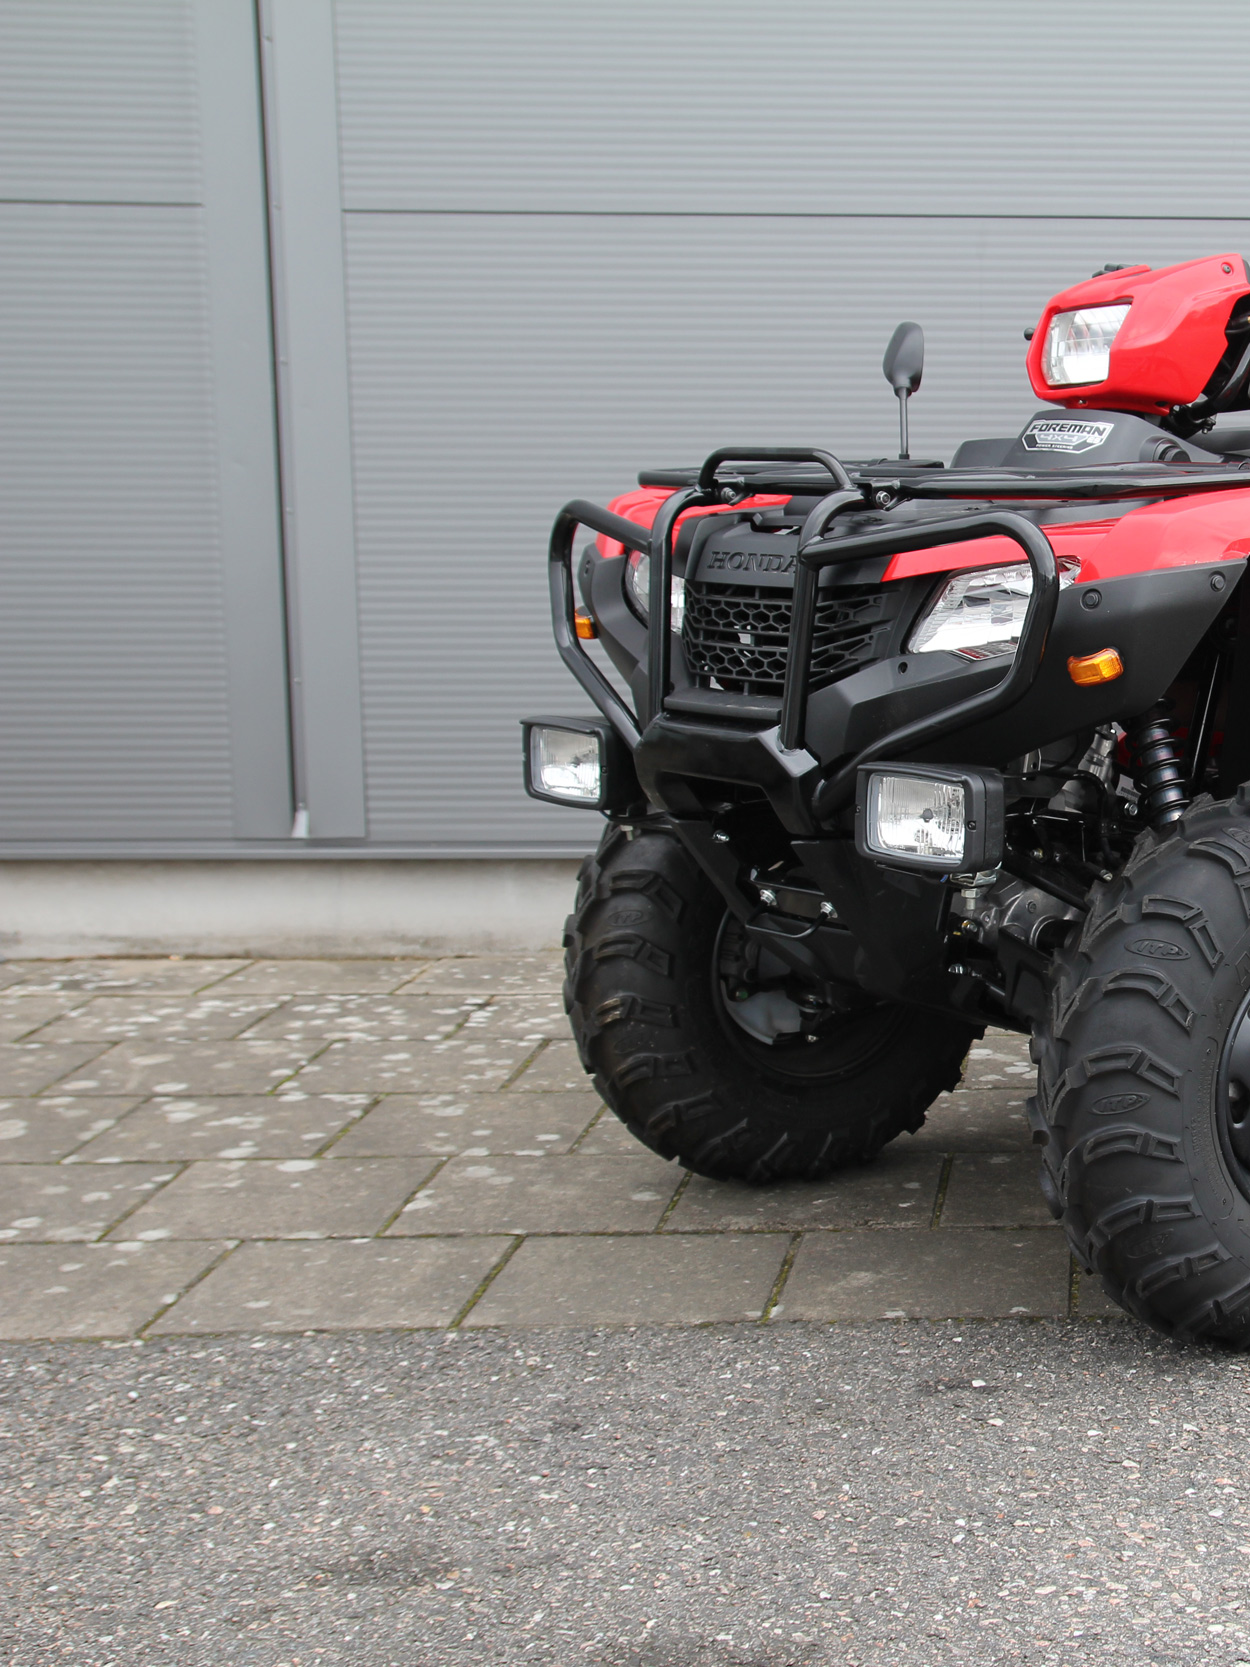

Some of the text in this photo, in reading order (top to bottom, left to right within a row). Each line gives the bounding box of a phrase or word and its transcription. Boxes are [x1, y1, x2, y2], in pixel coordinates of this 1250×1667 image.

[1029, 423, 1107, 436] FOREMAN
[707, 551, 798, 575] HONDA
[1136, 943, 1182, 957] ITP
